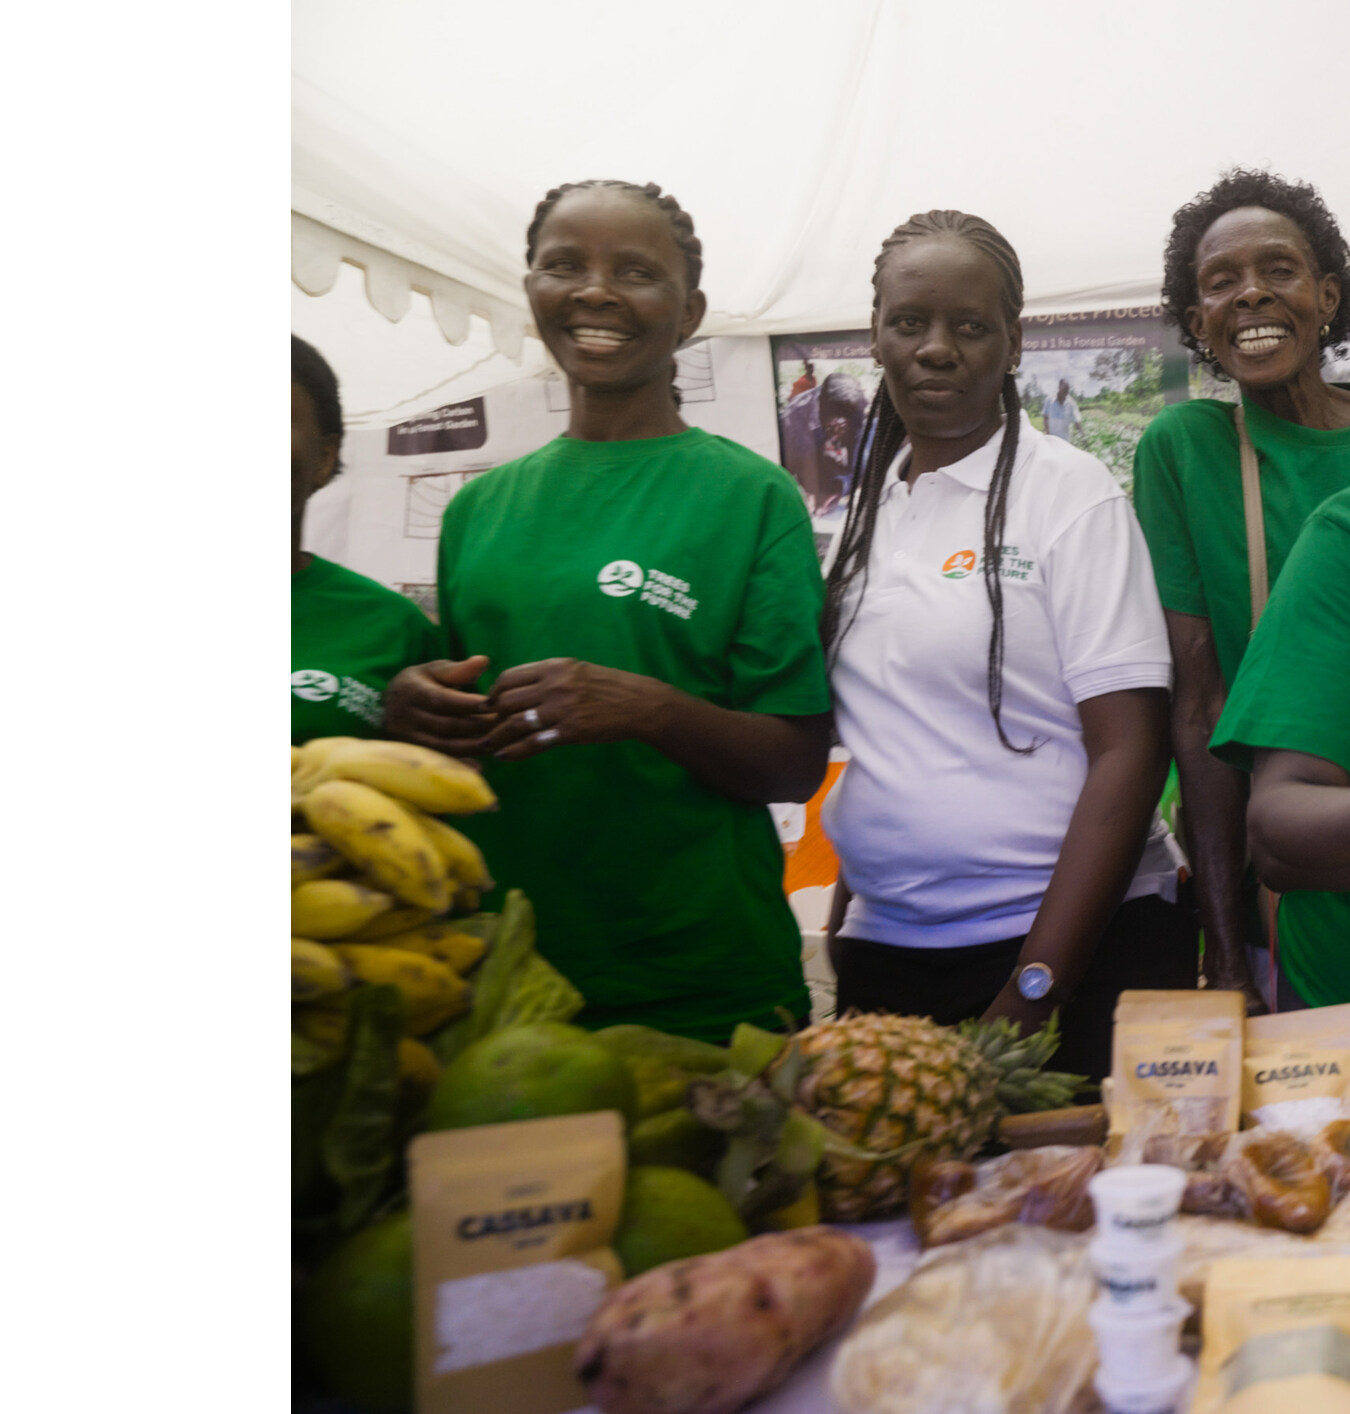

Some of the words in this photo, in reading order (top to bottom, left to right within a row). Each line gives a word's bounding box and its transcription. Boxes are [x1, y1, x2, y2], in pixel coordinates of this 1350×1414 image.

[1073, 336, 1105, 348] Forest
[1108, 334, 1145, 346] Garden
[1009, 558, 1035, 570] THE
[1135, 1061, 1219, 1079] CASSAVA
[1255, 1062, 1341, 1085] CASSAVA
[457, 1200, 595, 1241] CASSAVA
